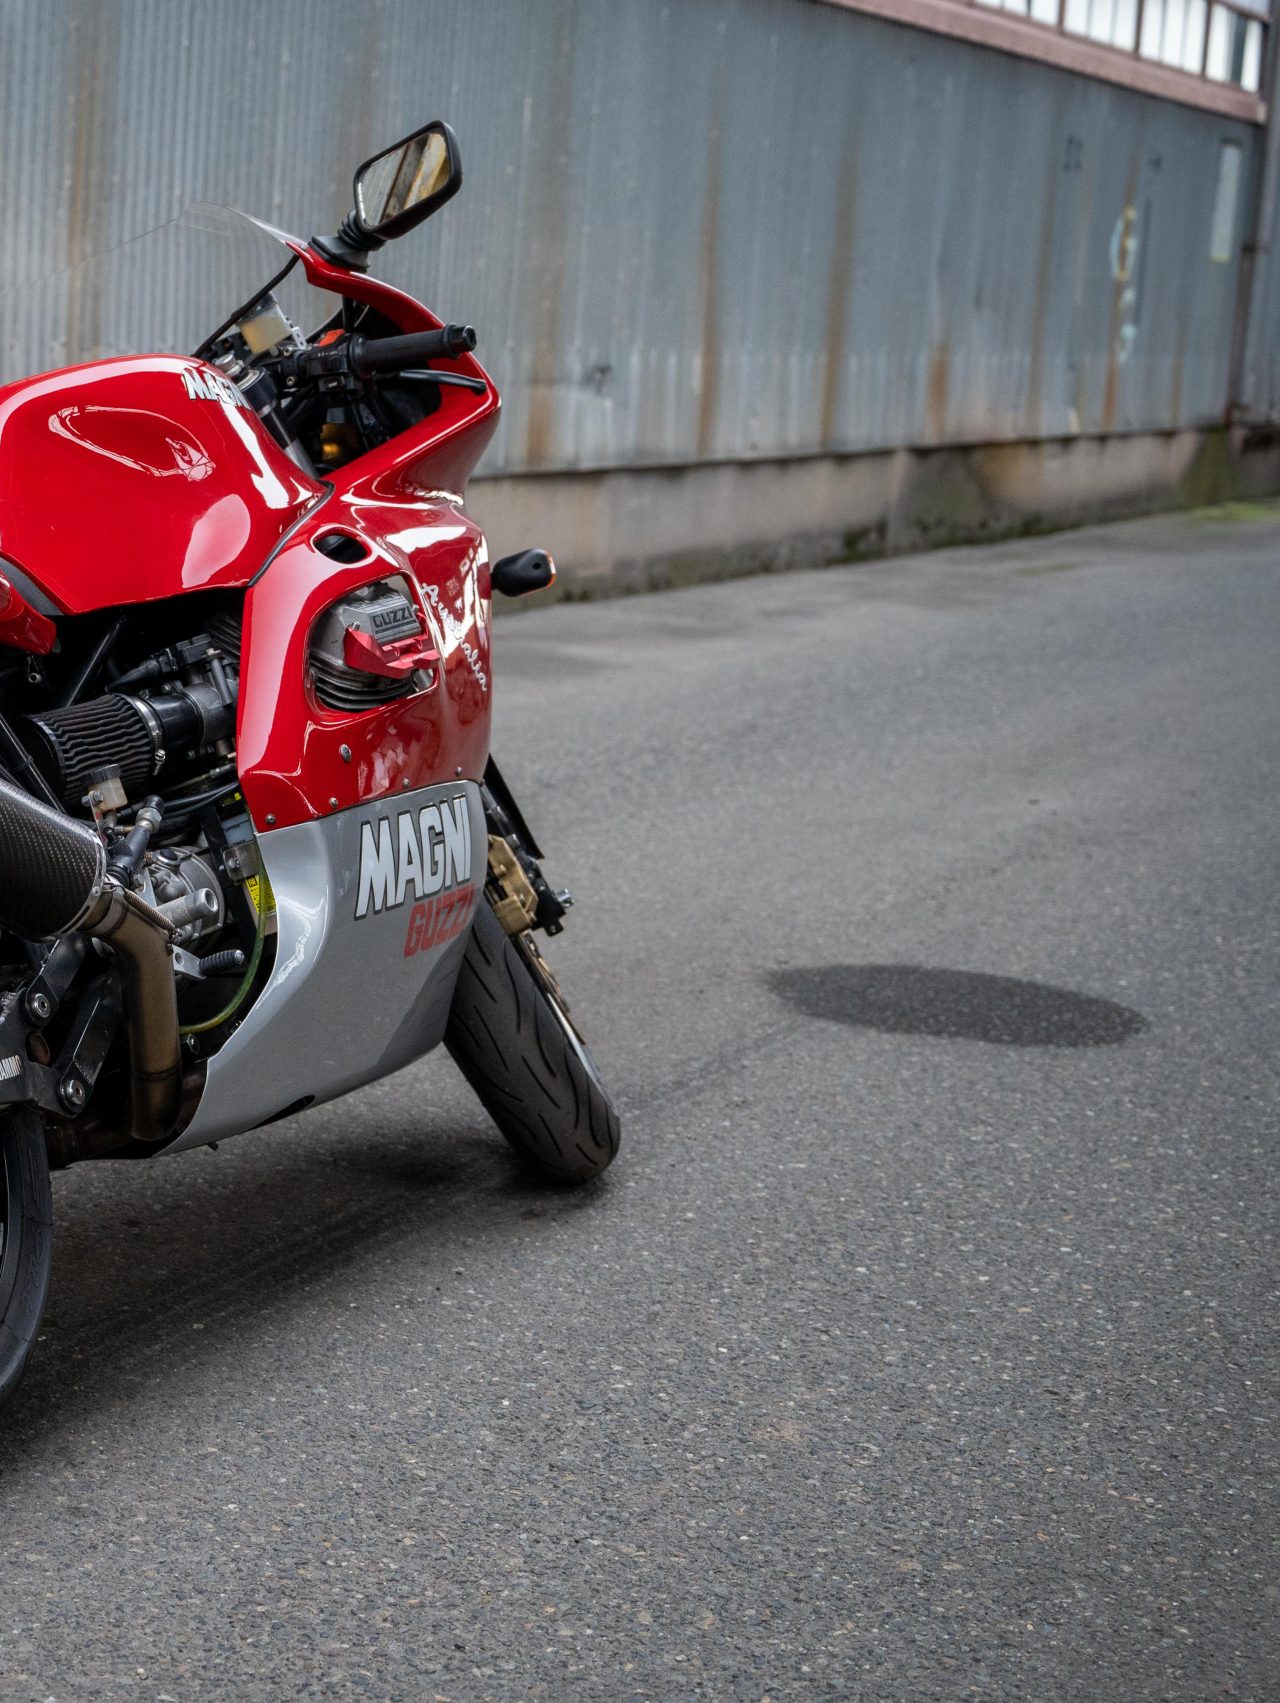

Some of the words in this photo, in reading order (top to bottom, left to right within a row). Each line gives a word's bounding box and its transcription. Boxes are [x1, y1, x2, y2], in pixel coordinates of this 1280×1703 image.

[372, 606, 413, 629] GUZZI
[354, 793, 471, 921] MAGNI
[403, 882, 476, 959] GUZZI
